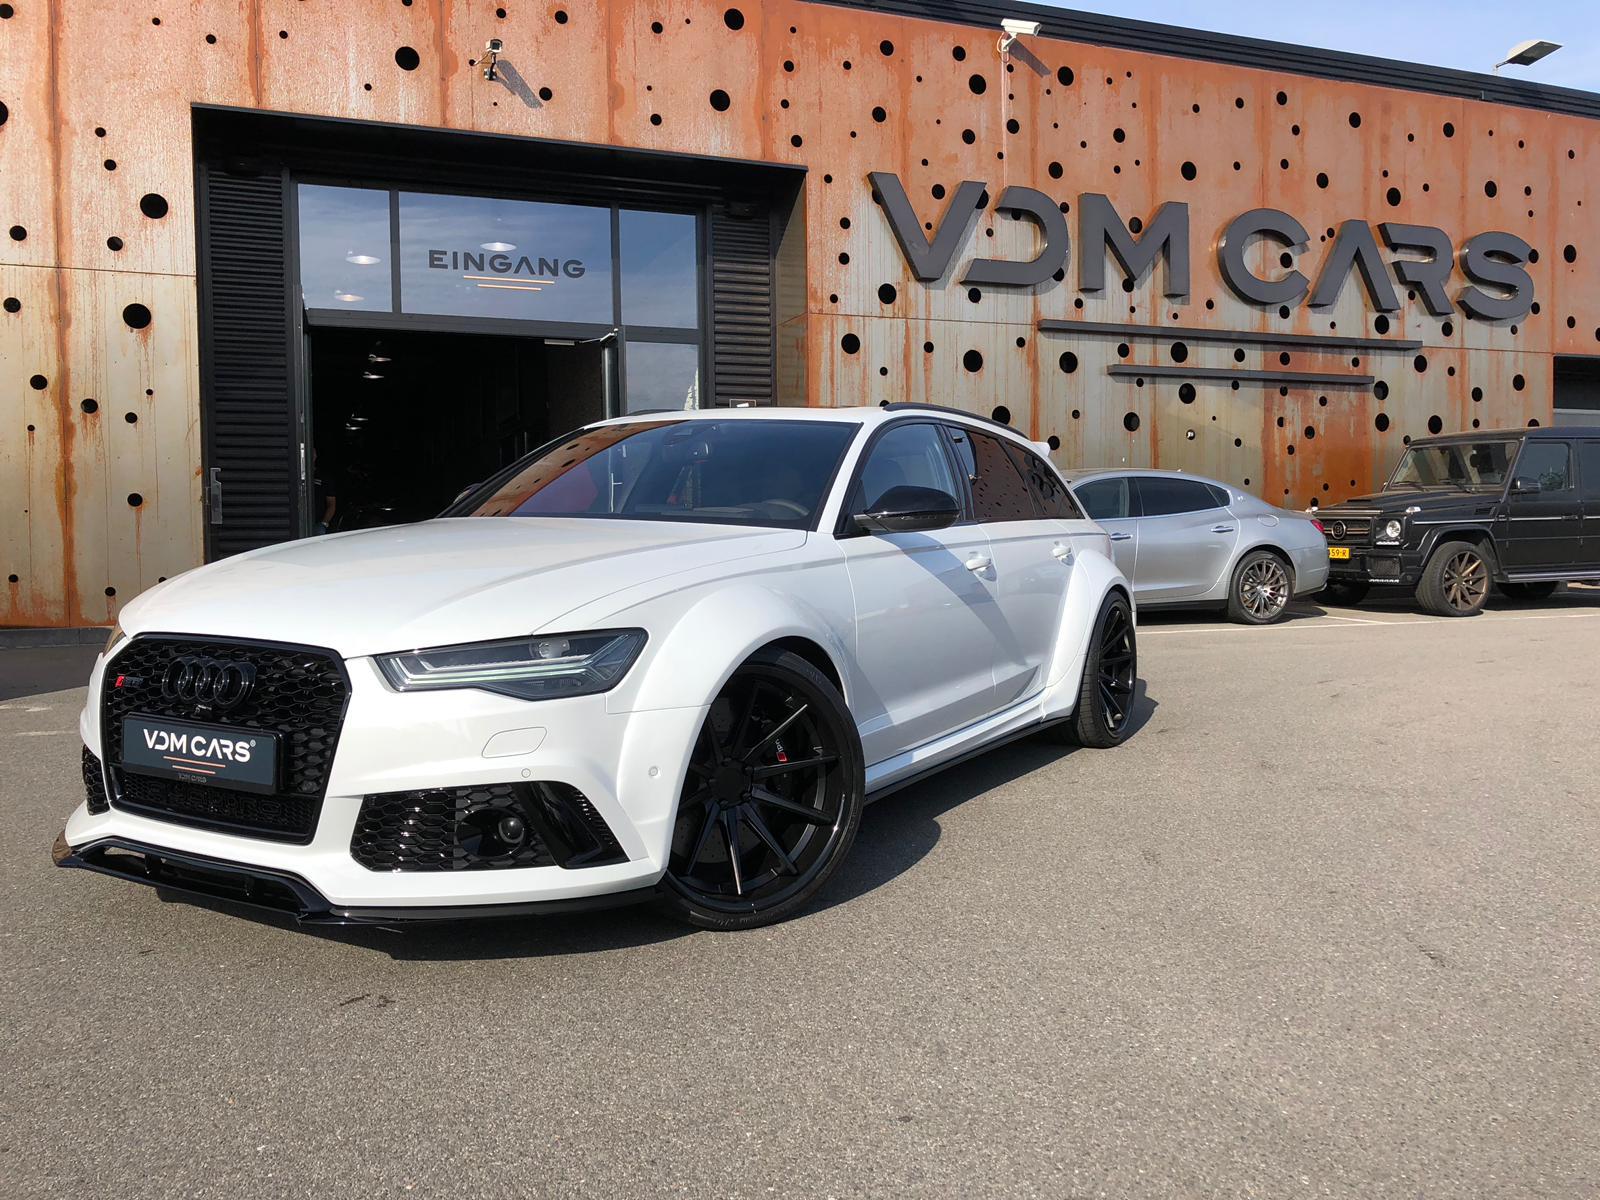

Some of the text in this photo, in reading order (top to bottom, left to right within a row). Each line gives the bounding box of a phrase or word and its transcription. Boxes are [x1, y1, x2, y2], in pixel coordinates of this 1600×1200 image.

[867, 171, 1536, 321] VDM CARS
[428, 249, 586, 279] EINGANG
[143, 729, 187, 754] VDM
